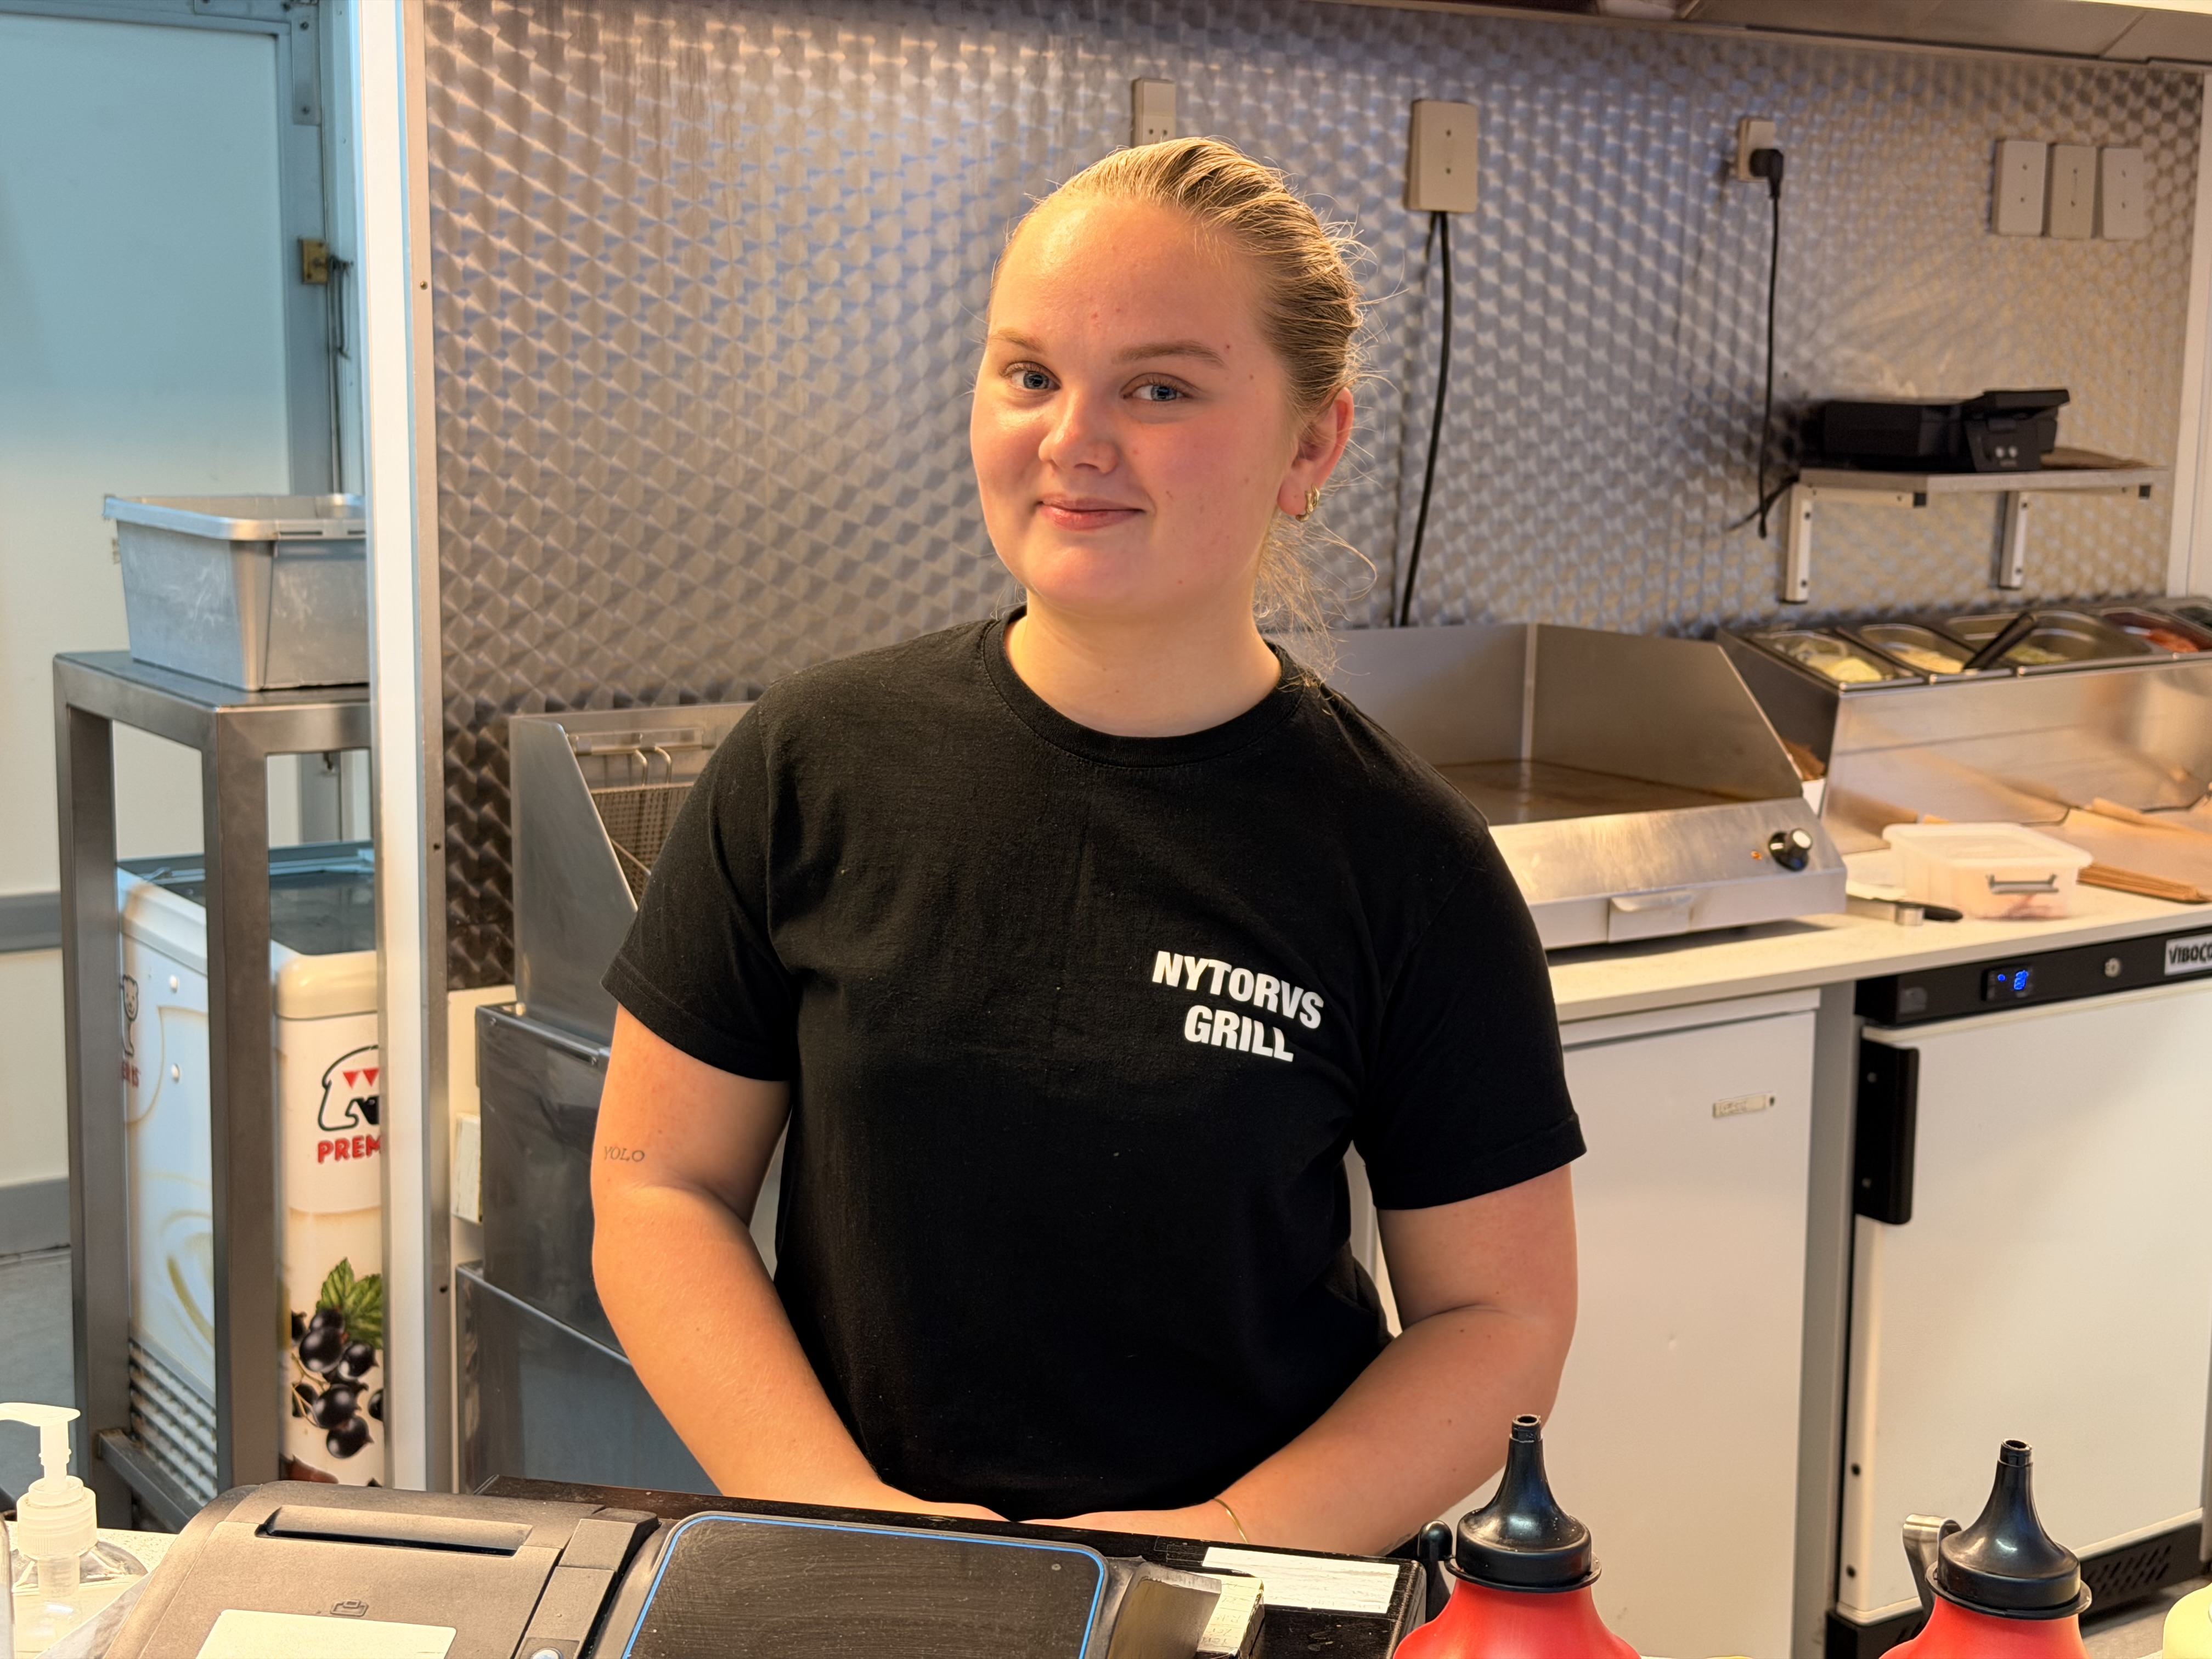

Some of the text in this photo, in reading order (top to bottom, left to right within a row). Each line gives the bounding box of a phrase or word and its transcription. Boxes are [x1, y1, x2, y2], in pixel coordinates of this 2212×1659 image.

[1152, 951, 1324, 1029] NYTORVS
[1184, 1005, 1294, 1063] GRILL
[604, 1146, 645, 1162] YOLO
